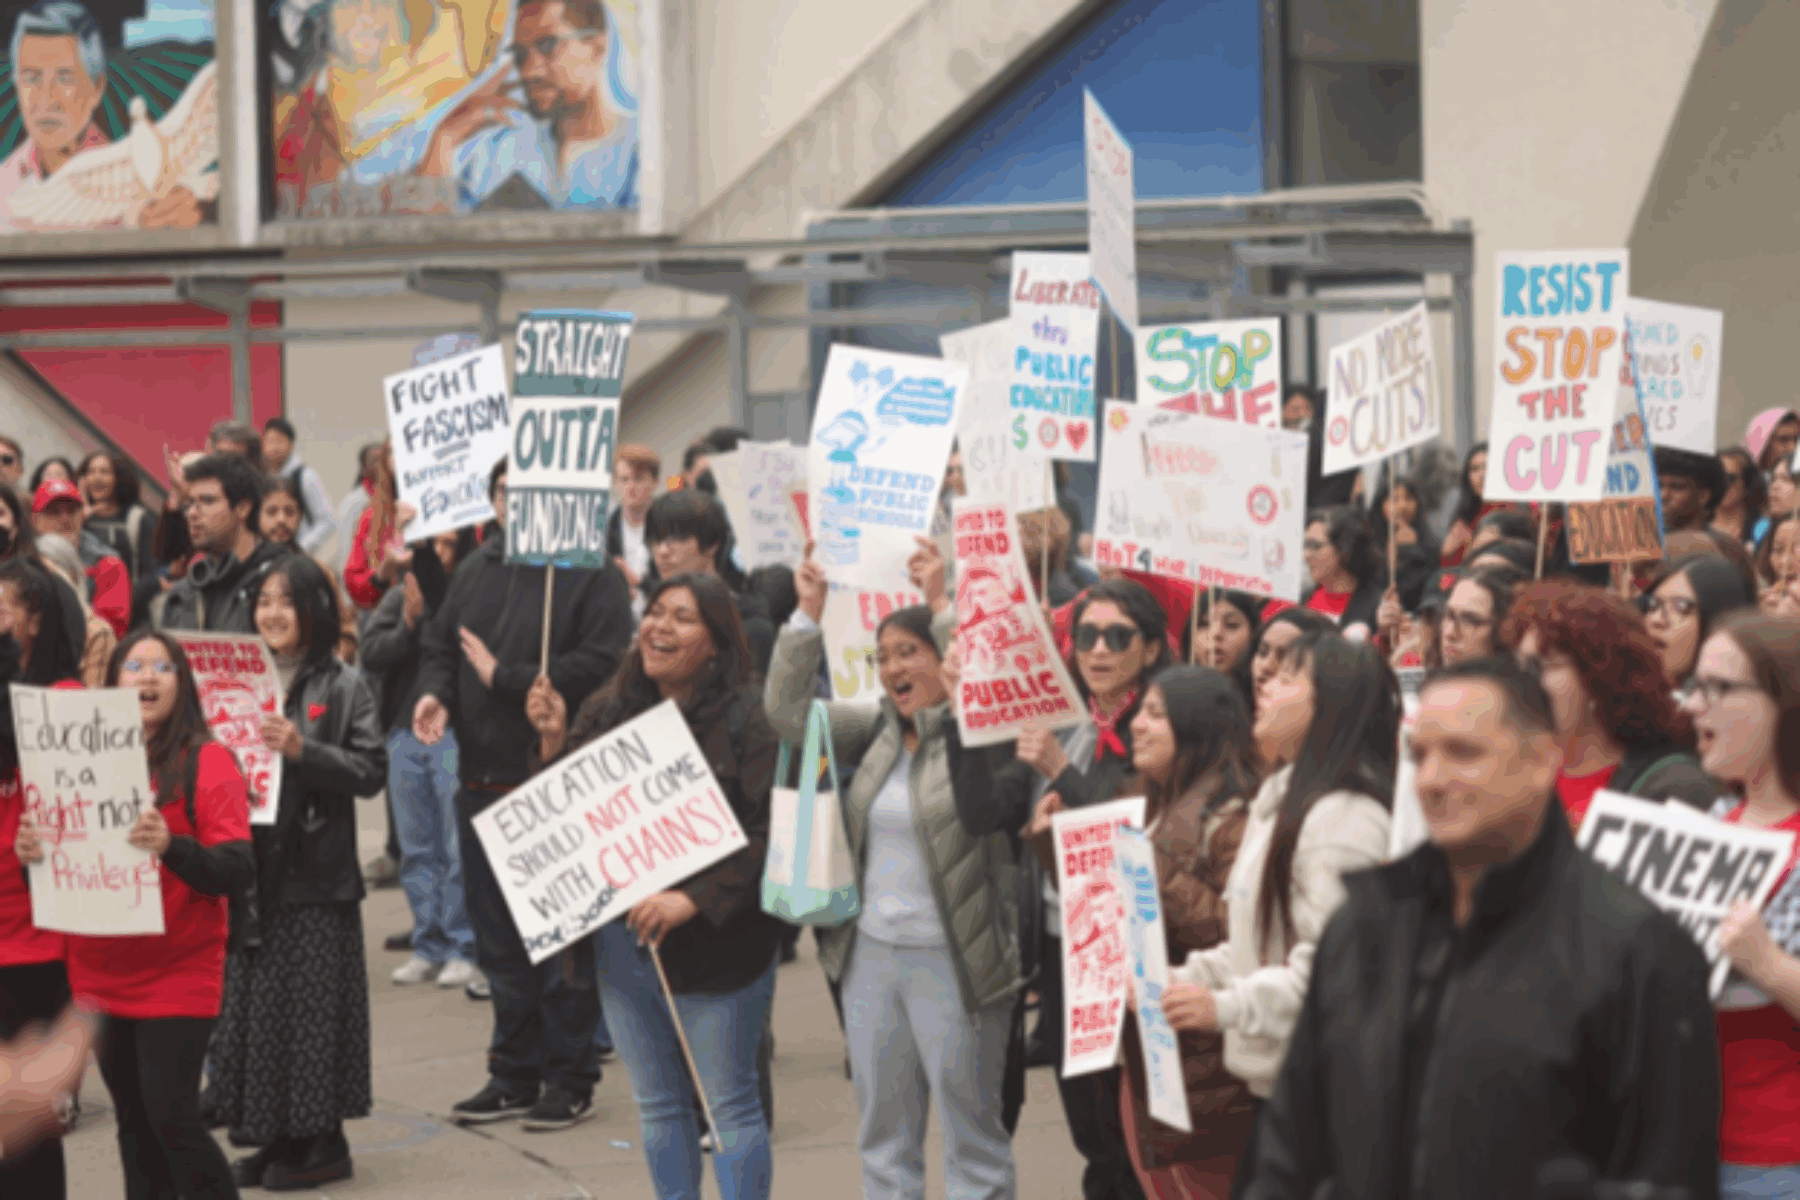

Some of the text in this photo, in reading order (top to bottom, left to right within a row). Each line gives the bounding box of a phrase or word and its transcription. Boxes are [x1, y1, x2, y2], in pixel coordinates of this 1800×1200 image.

[1502, 261, 1621, 318] RESIST
[514, 319, 634, 380] STRAIGHT
[1014, 345, 1094, 388] PUBLIC
[1146, 325, 1273, 394] STOP
[1500, 326, 1617, 385] STOP
[391, 356, 482, 416] FIGHT
[1517, 383, 1588, 421] THE
[402, 391, 510, 453] FASCISM
[514, 405, 616, 474] OUTTA
[850, 464, 936, 494] DEFEND
[1504, 430, 1602, 492] CUT
[506, 490, 605, 558] FUNDING
[858, 486, 930, 512] PUBLIC
[237, 642, 261, 657] TO
[962, 670, 1061, 709] PUBLIC
[964, 696, 1070, 730] EDUCATION
[13, 690, 146, 756] Education
[79, 766, 96, 787] a
[493, 729, 654, 846] EDUCATION
[24, 782, 143, 846] Right not
[506, 752, 707, 889] SHOULD NOT COME
[529, 785, 740, 922] WITH CHAINS!
